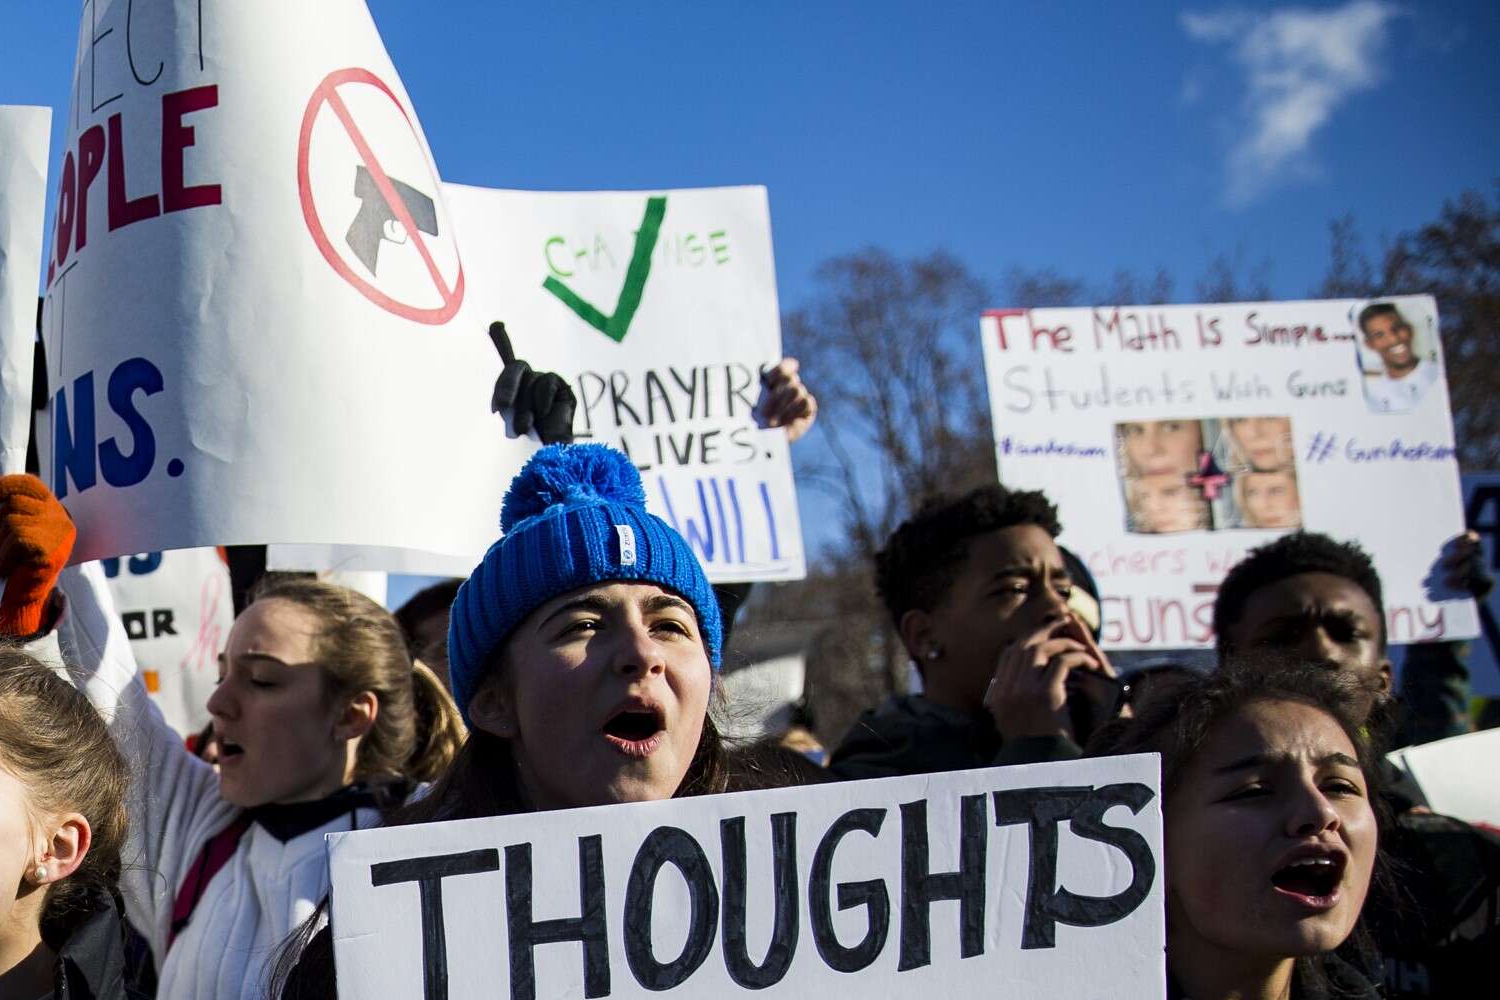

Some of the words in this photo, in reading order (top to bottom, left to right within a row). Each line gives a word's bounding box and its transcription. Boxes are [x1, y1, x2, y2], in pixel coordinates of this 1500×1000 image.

[47, 83, 223, 290] OPLE
[981, 307, 1074, 354] The
[1092, 306, 1182, 351] Math
[1003, 363, 1196, 415] Students
[50, 356, 186, 502] NS.
[1090, 543, 1187, 578] chers
[1386, 602, 1447, 641] ny
